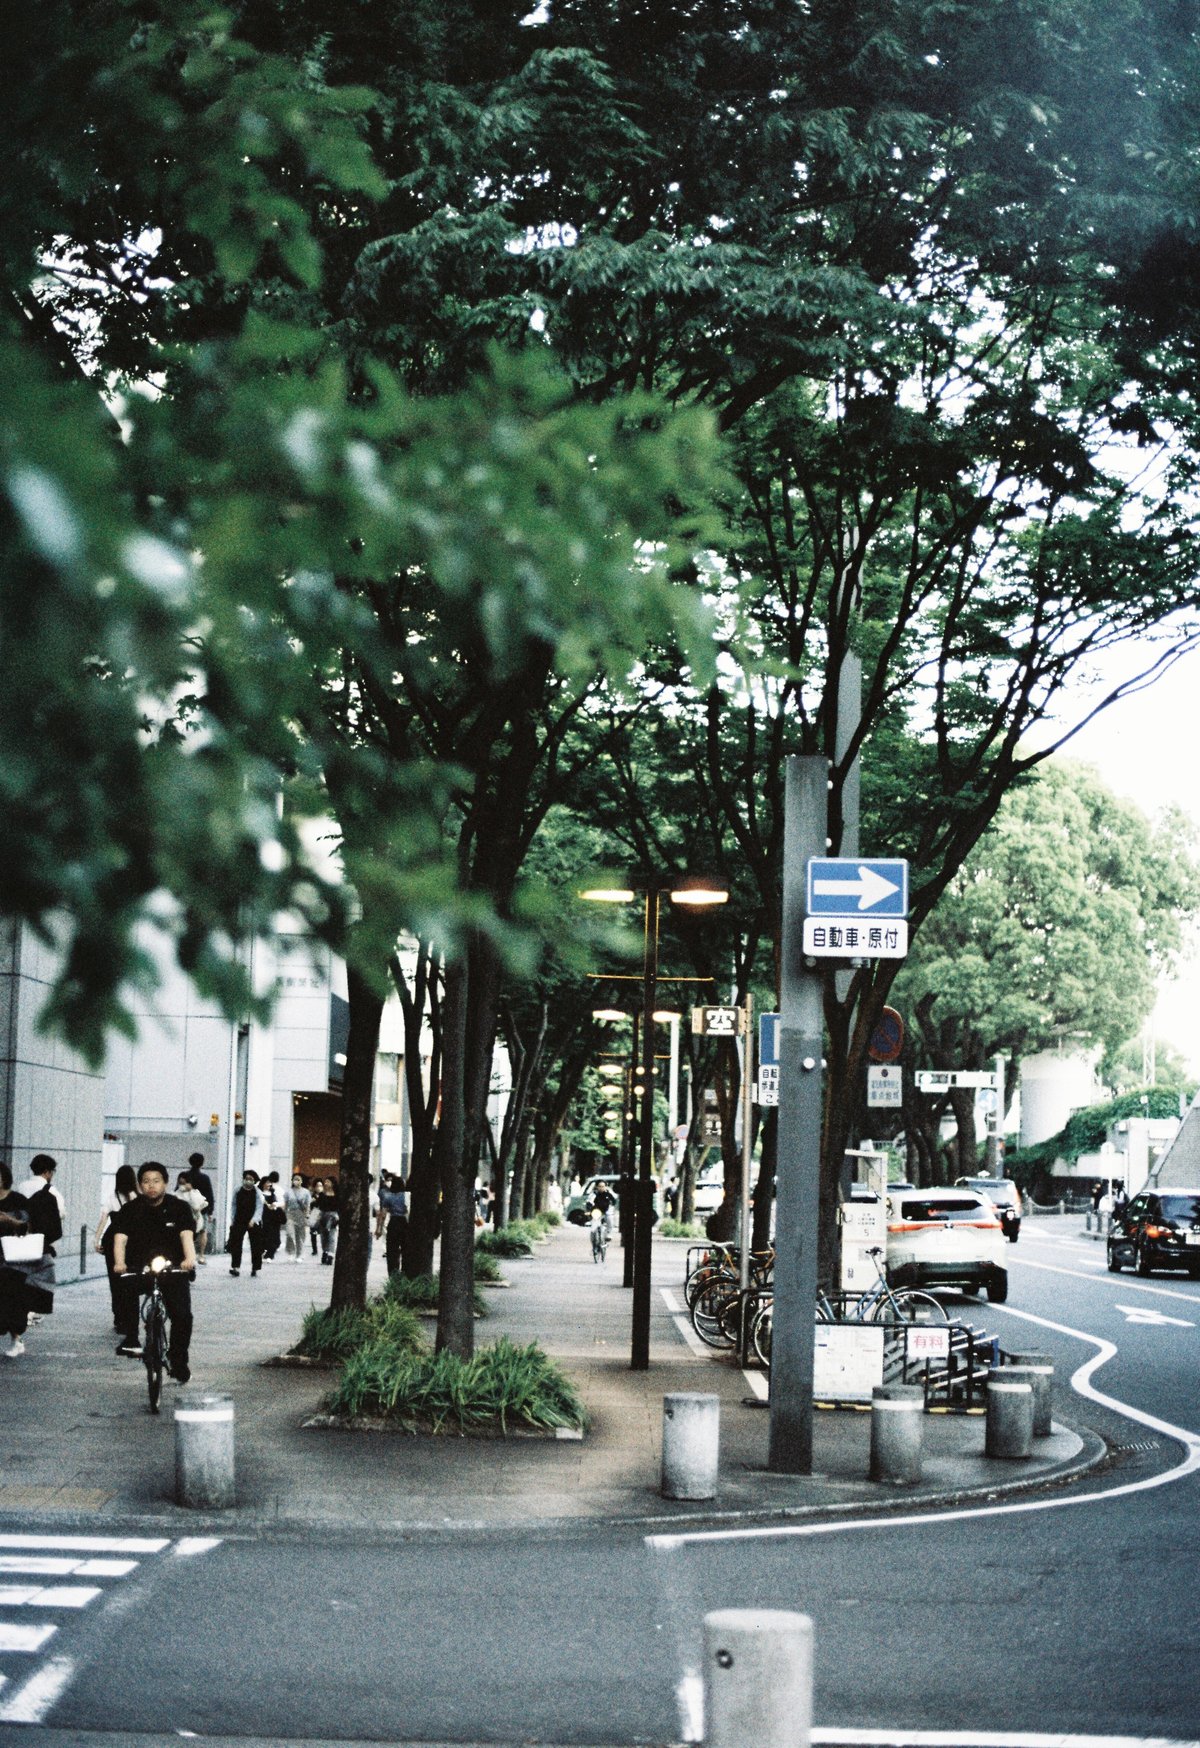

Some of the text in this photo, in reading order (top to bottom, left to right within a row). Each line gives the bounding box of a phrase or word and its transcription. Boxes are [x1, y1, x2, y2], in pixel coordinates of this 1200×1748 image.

[813, 926, 899, 949] 自動車・原付
